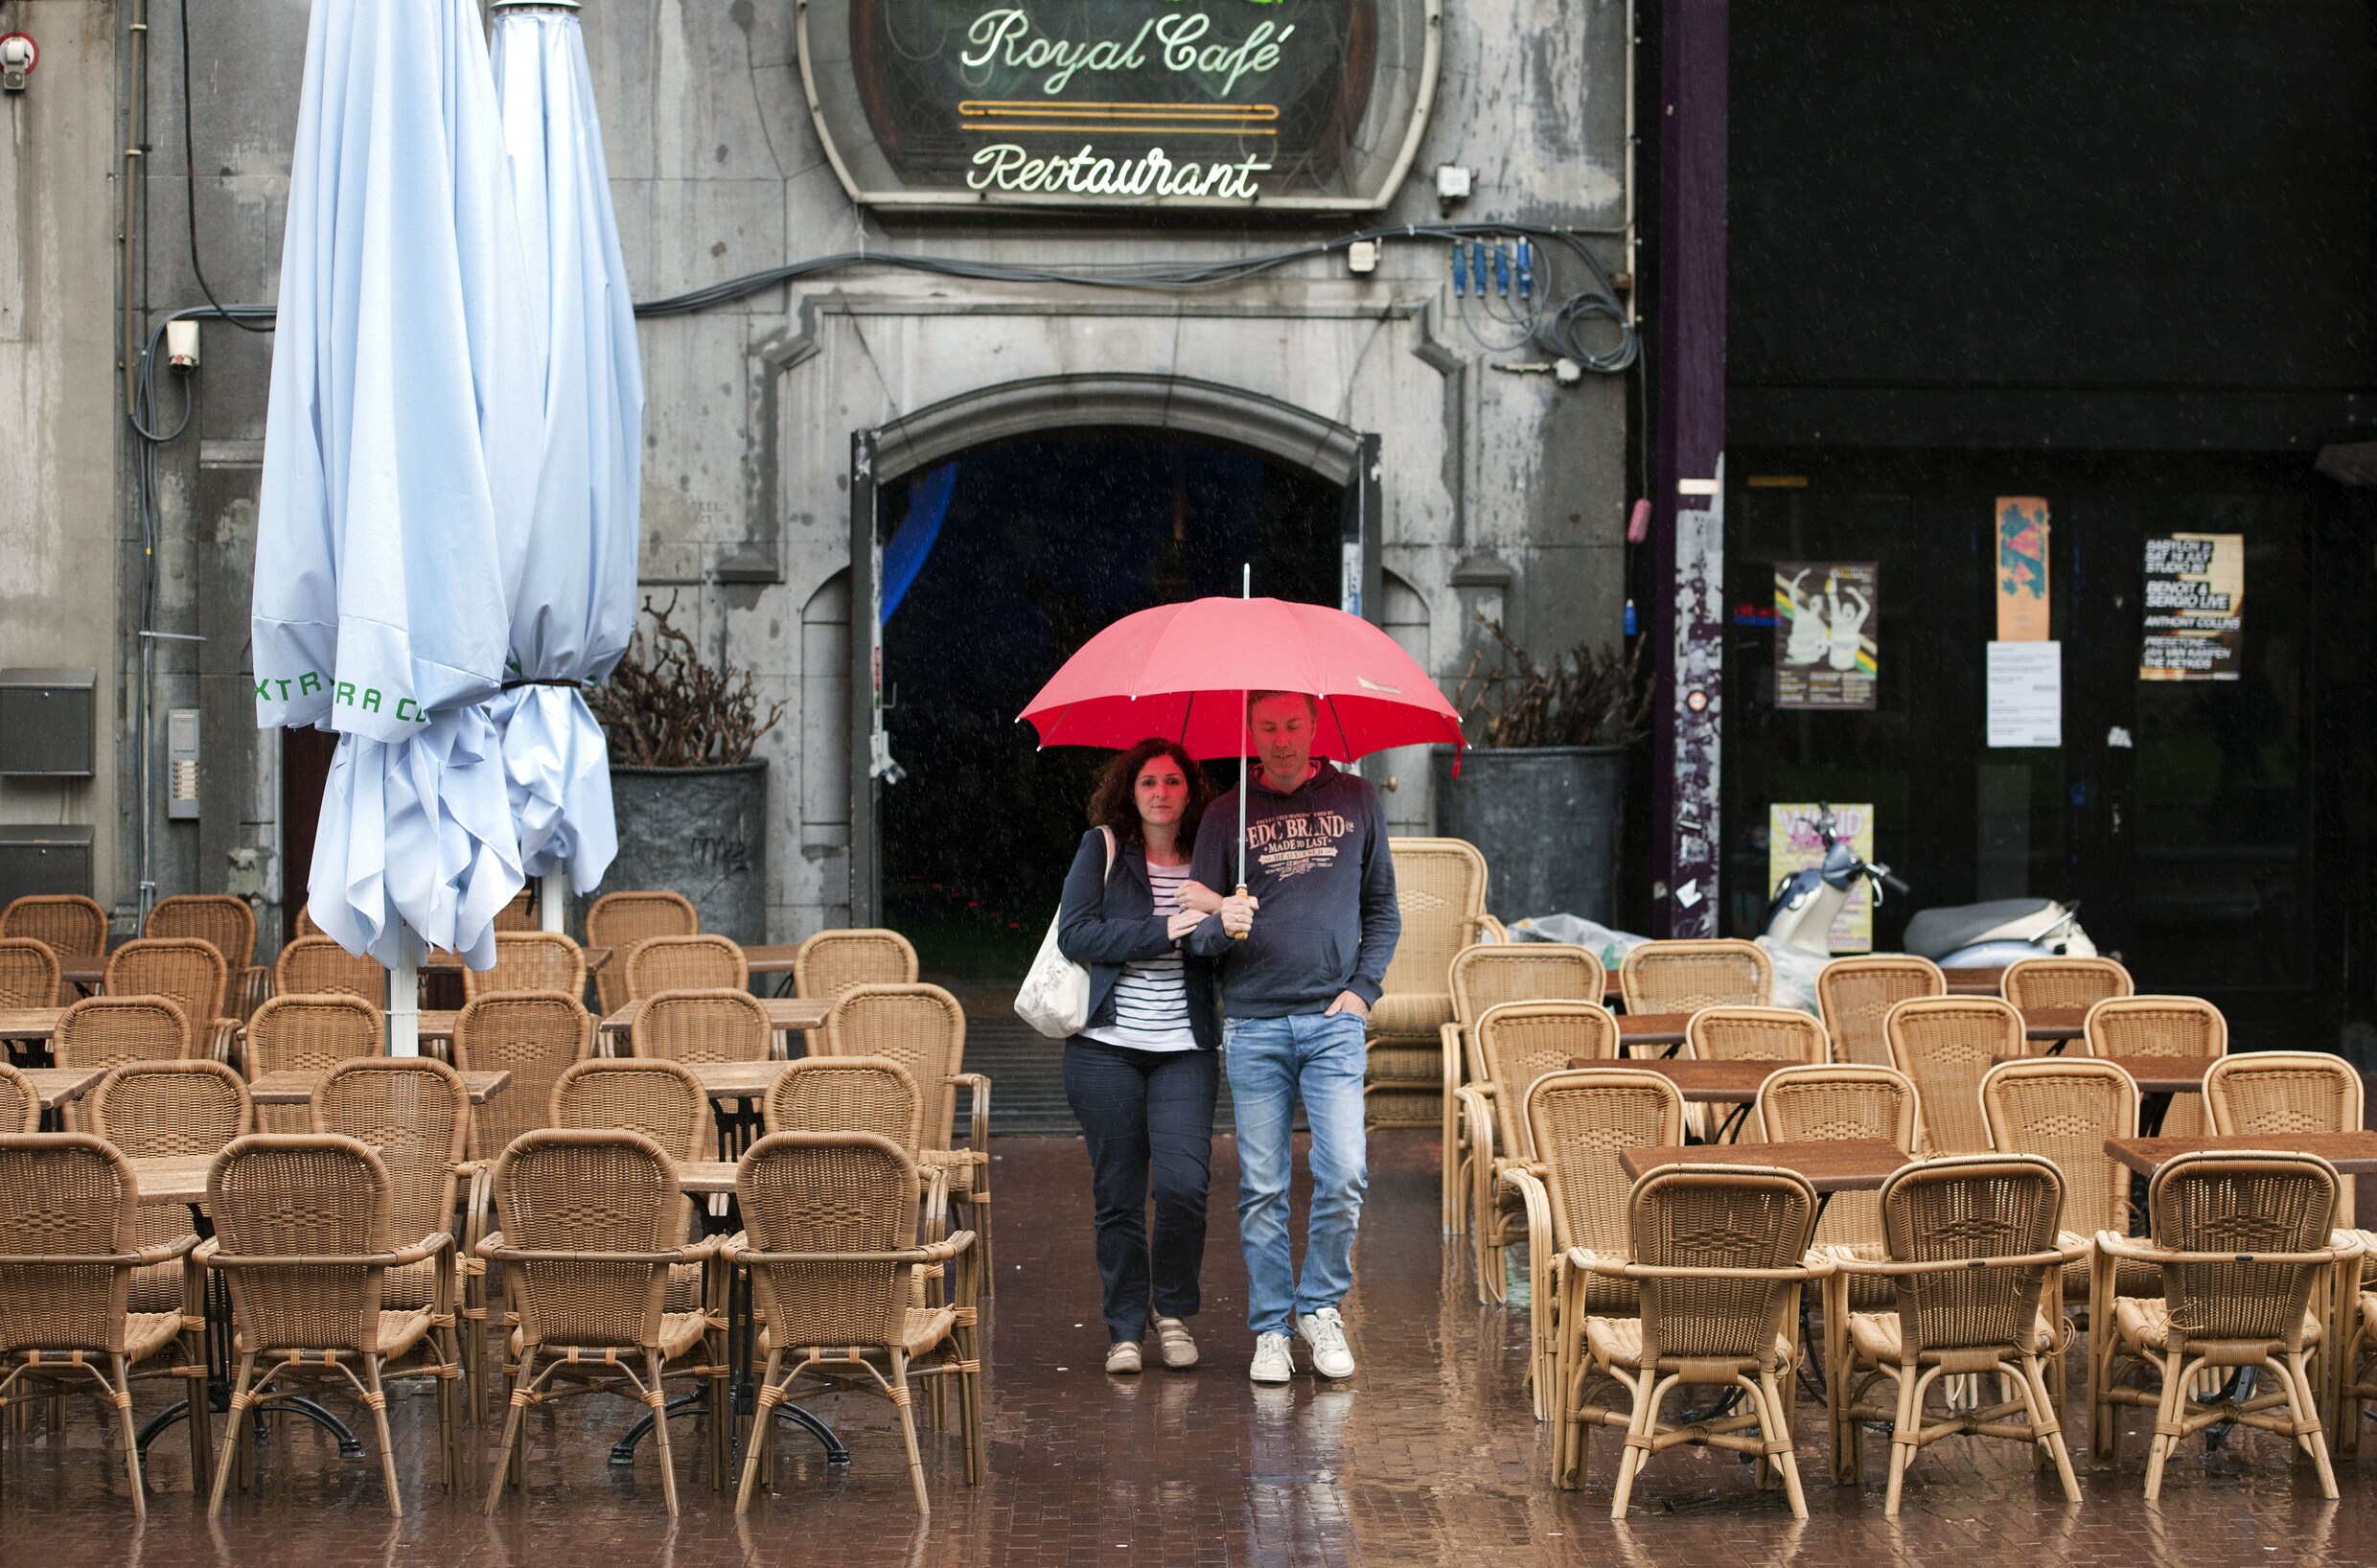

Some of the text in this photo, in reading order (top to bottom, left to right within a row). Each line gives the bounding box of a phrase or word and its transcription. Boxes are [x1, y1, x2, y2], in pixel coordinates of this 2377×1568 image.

[961, 9, 1295, 96] Royal Café
[966, 144, 1272, 197] Restaurant
[2145, 562, 2190, 573] STUDIO
[2146, 581, 2197, 595] BENOIT
[2200, 595, 2228, 609] LIVE
[2144, 615, 2241, 630] ANTHONY COLLINS
[254, 671, 335, 701] XTR
[1246, 821, 1282, 850] EDC
[1286, 816, 1345, 838] BRAND
[1269, 839, 1296, 853] MADE
[1305, 837, 1327, 849] LAST
